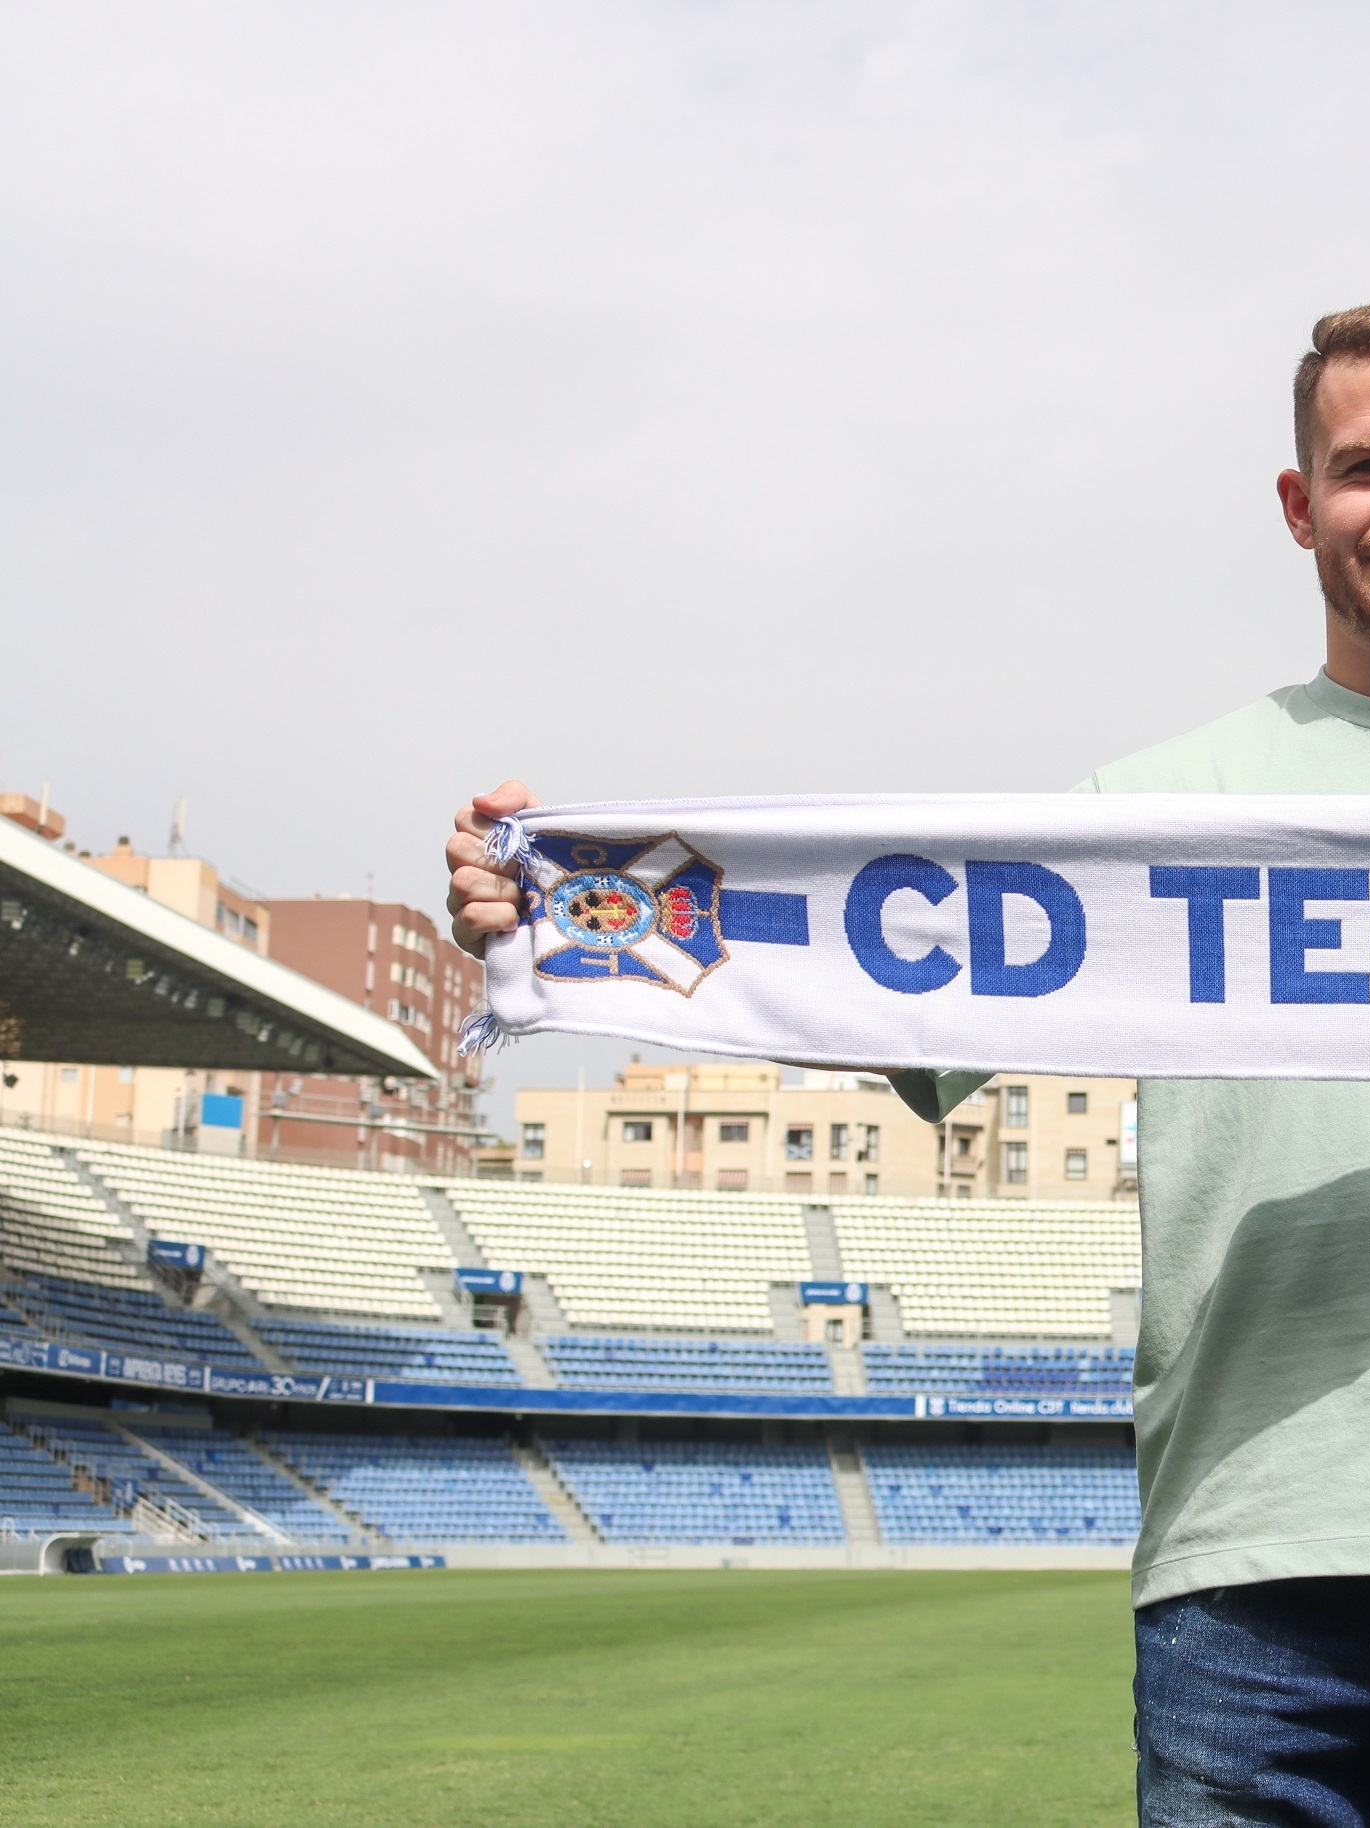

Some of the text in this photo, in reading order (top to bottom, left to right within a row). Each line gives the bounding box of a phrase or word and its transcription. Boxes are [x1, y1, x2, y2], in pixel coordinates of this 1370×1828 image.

[844, 853, 1087, 998] CD
[949, 1399, 992, 1414] Tienda
[993, 1398, 1036, 1415] Online
[1037, 1398, 1065, 1415] CDT
